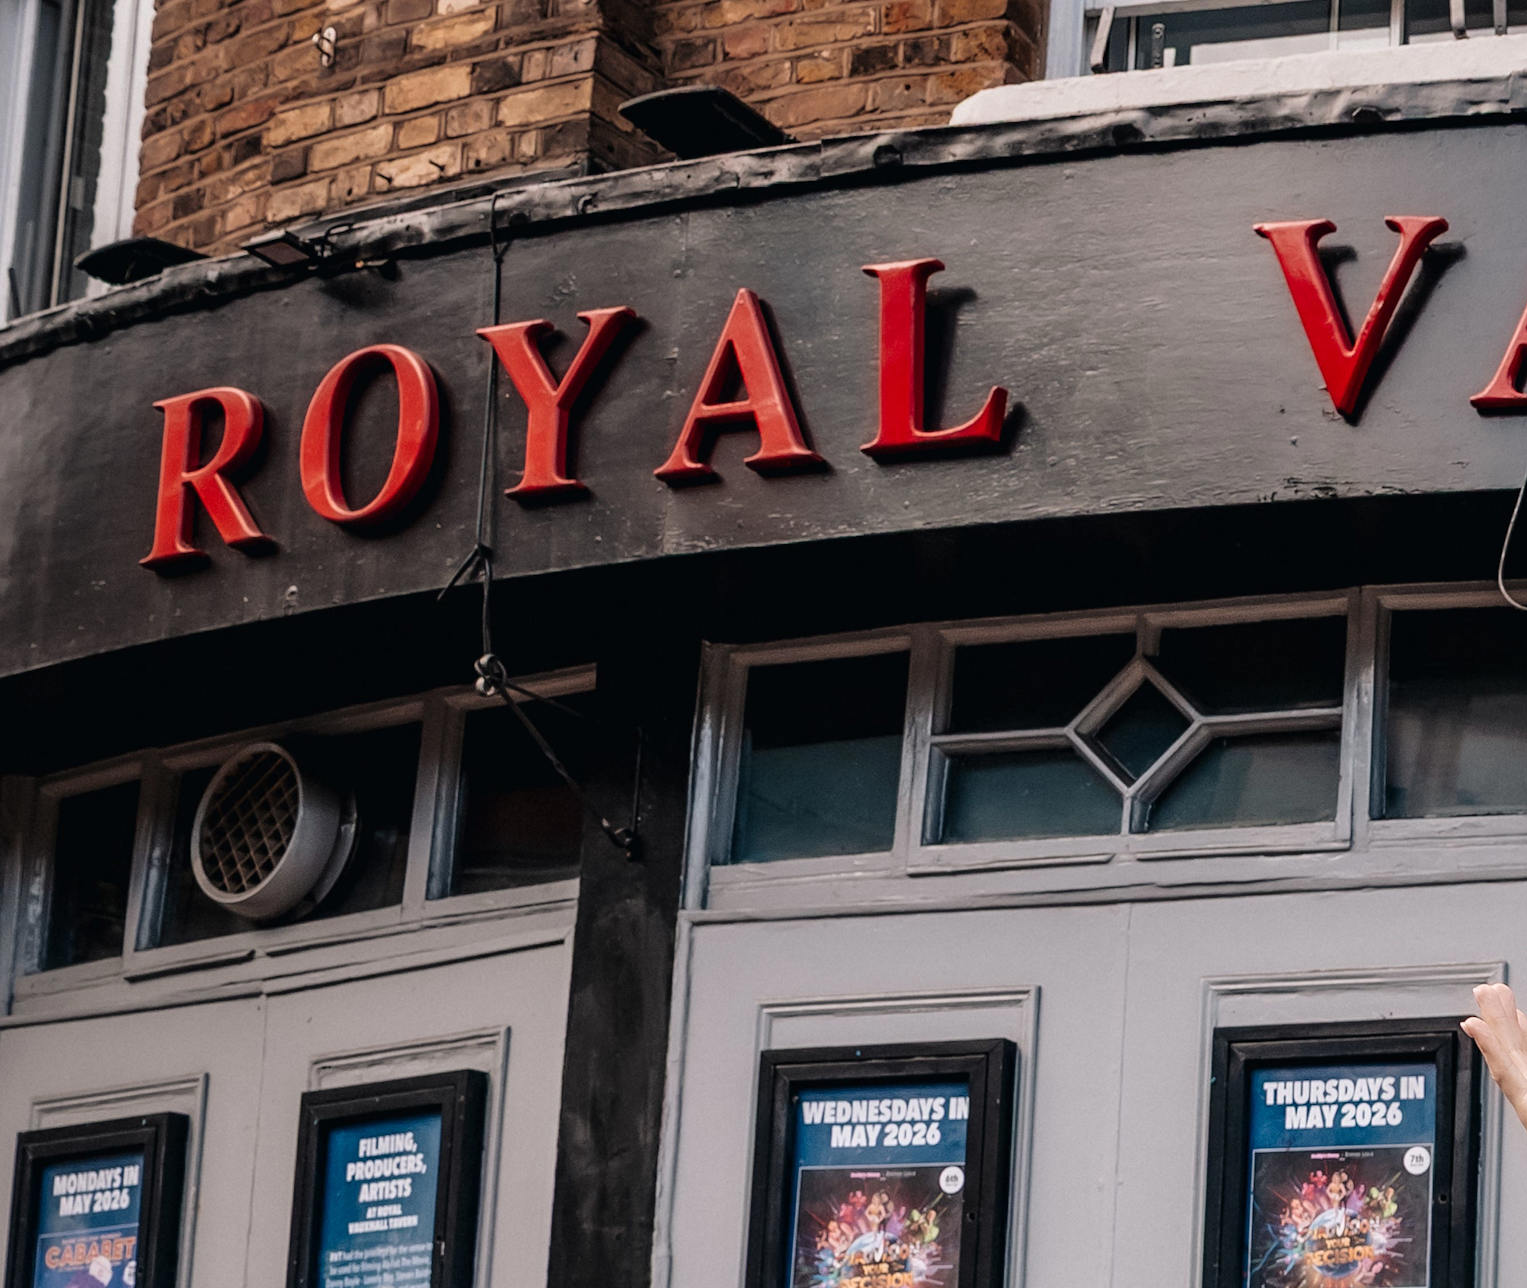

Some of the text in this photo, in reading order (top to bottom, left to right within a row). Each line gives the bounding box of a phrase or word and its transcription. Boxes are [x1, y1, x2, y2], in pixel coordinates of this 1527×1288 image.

[138, 257, 1008, 569] ROYAL
[1263, 1075, 1425, 1105] THURSDAYS IN
[801, 1096, 969, 1125] WEDNESDAYS IN
[1285, 1102, 1403, 1130] MAY 2026
[358, 1131, 417, 1158] FILMING,
[830, 1122, 941, 1148] MAY 2026
[53, 1164, 140, 1197] MONDAYS IN
[346, 1154, 427, 1182] PRODUCERS,
[59, 1188, 131, 1217] MAY 2026
[358, 1178, 412, 1203] ARTISTS
